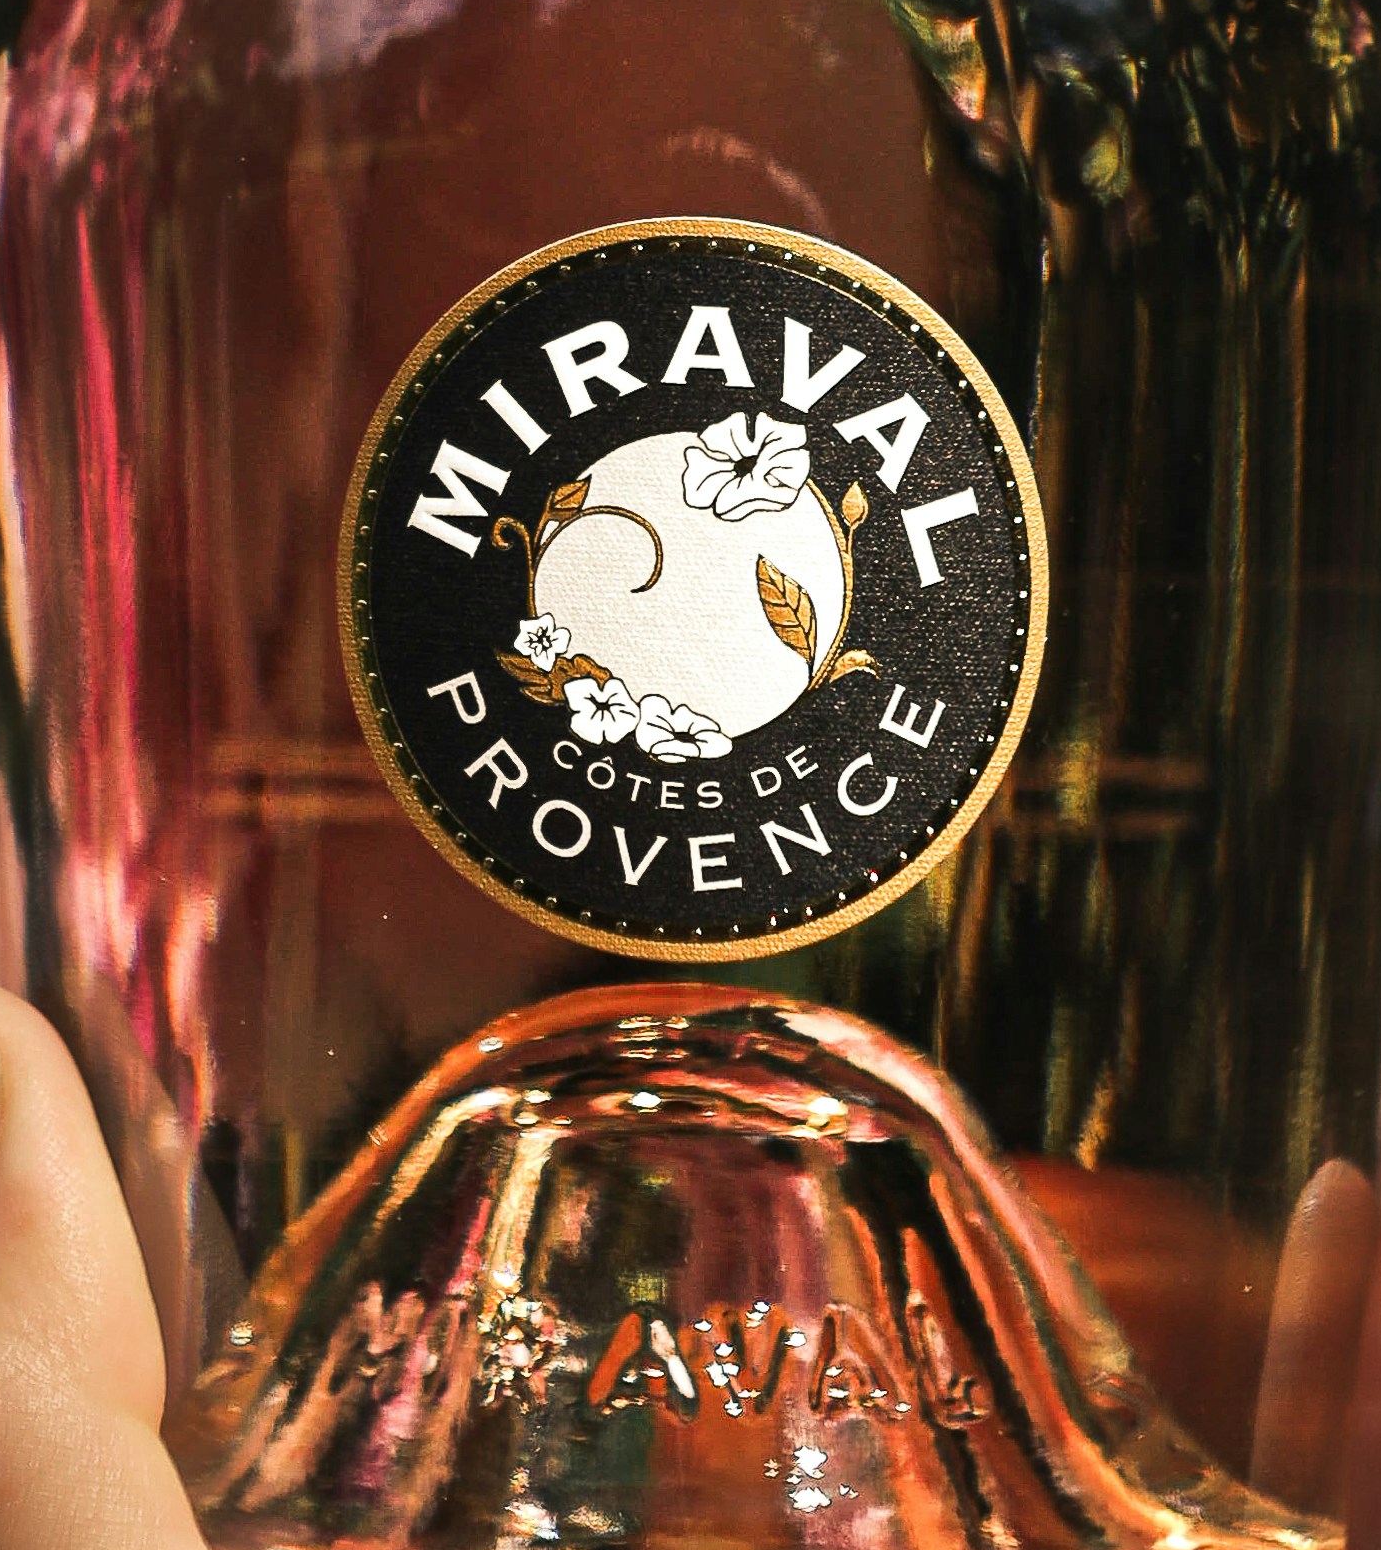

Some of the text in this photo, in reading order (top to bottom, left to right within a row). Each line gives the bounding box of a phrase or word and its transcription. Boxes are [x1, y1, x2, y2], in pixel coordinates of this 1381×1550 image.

[406, 304, 980, 589] MIRAVAL
[425, 670, 948, 893] PROVENCE
[551, 739, 820, 811] CÔTES DE
